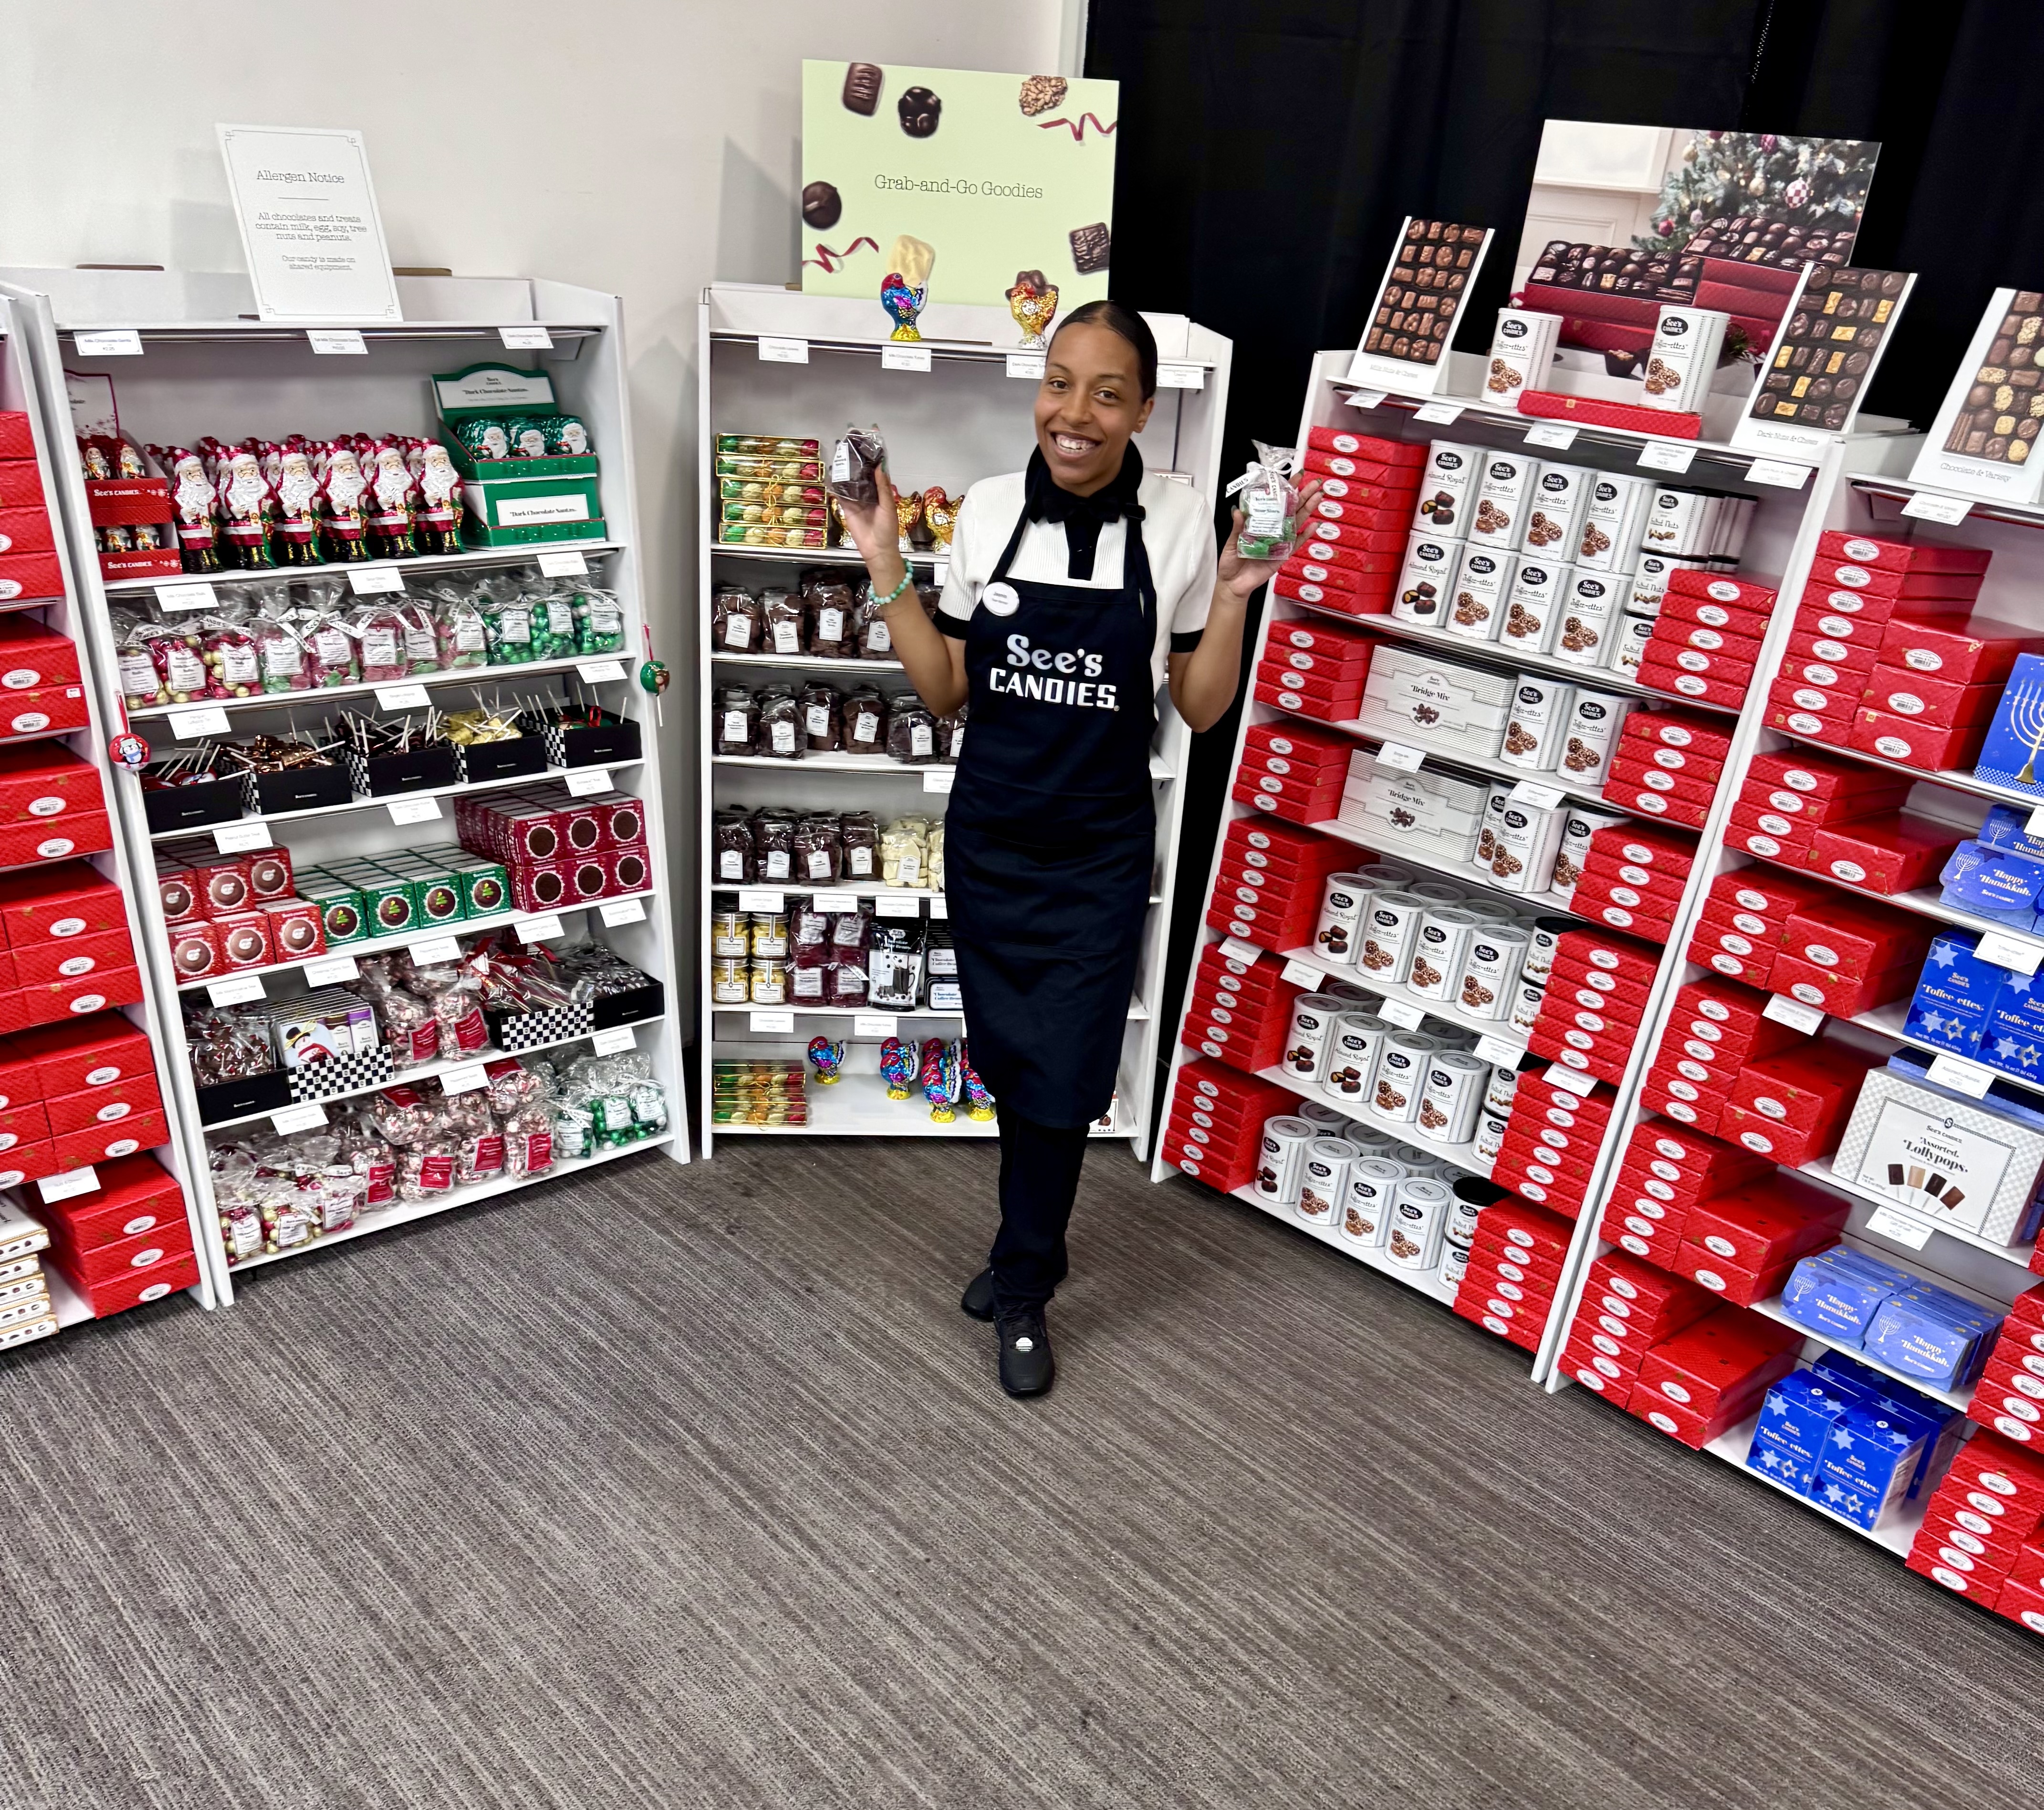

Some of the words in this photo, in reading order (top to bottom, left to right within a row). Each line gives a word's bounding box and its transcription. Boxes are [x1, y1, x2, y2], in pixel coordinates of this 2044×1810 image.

[257, 170, 305, 183] Allergen
[308, 172, 344, 183] Notice
[875, 174, 977, 195] Grab-and-Go
[981, 181, 1043, 198] Goodies
[255, 222, 288, 230] contain
[258, 212, 271, 220] All
[272, 213, 316, 222] chocolates
[336, 215, 361, 223] treats
[1007, 634, 1103, 677] See's
[990, 667, 1116, 709] CANDIES
[1411, 685, 1436, 697] Bridge
[1437, 692, 1450, 701] Mix
[1388, 789, 1411, 801] Bridge
[1412, 797, 1425, 806] Mix
[1993, 869, 2027, 885] Happy
[1827, 1294, 1858, 1313] Happy
[1913, 1335, 1945, 1355] Happy
